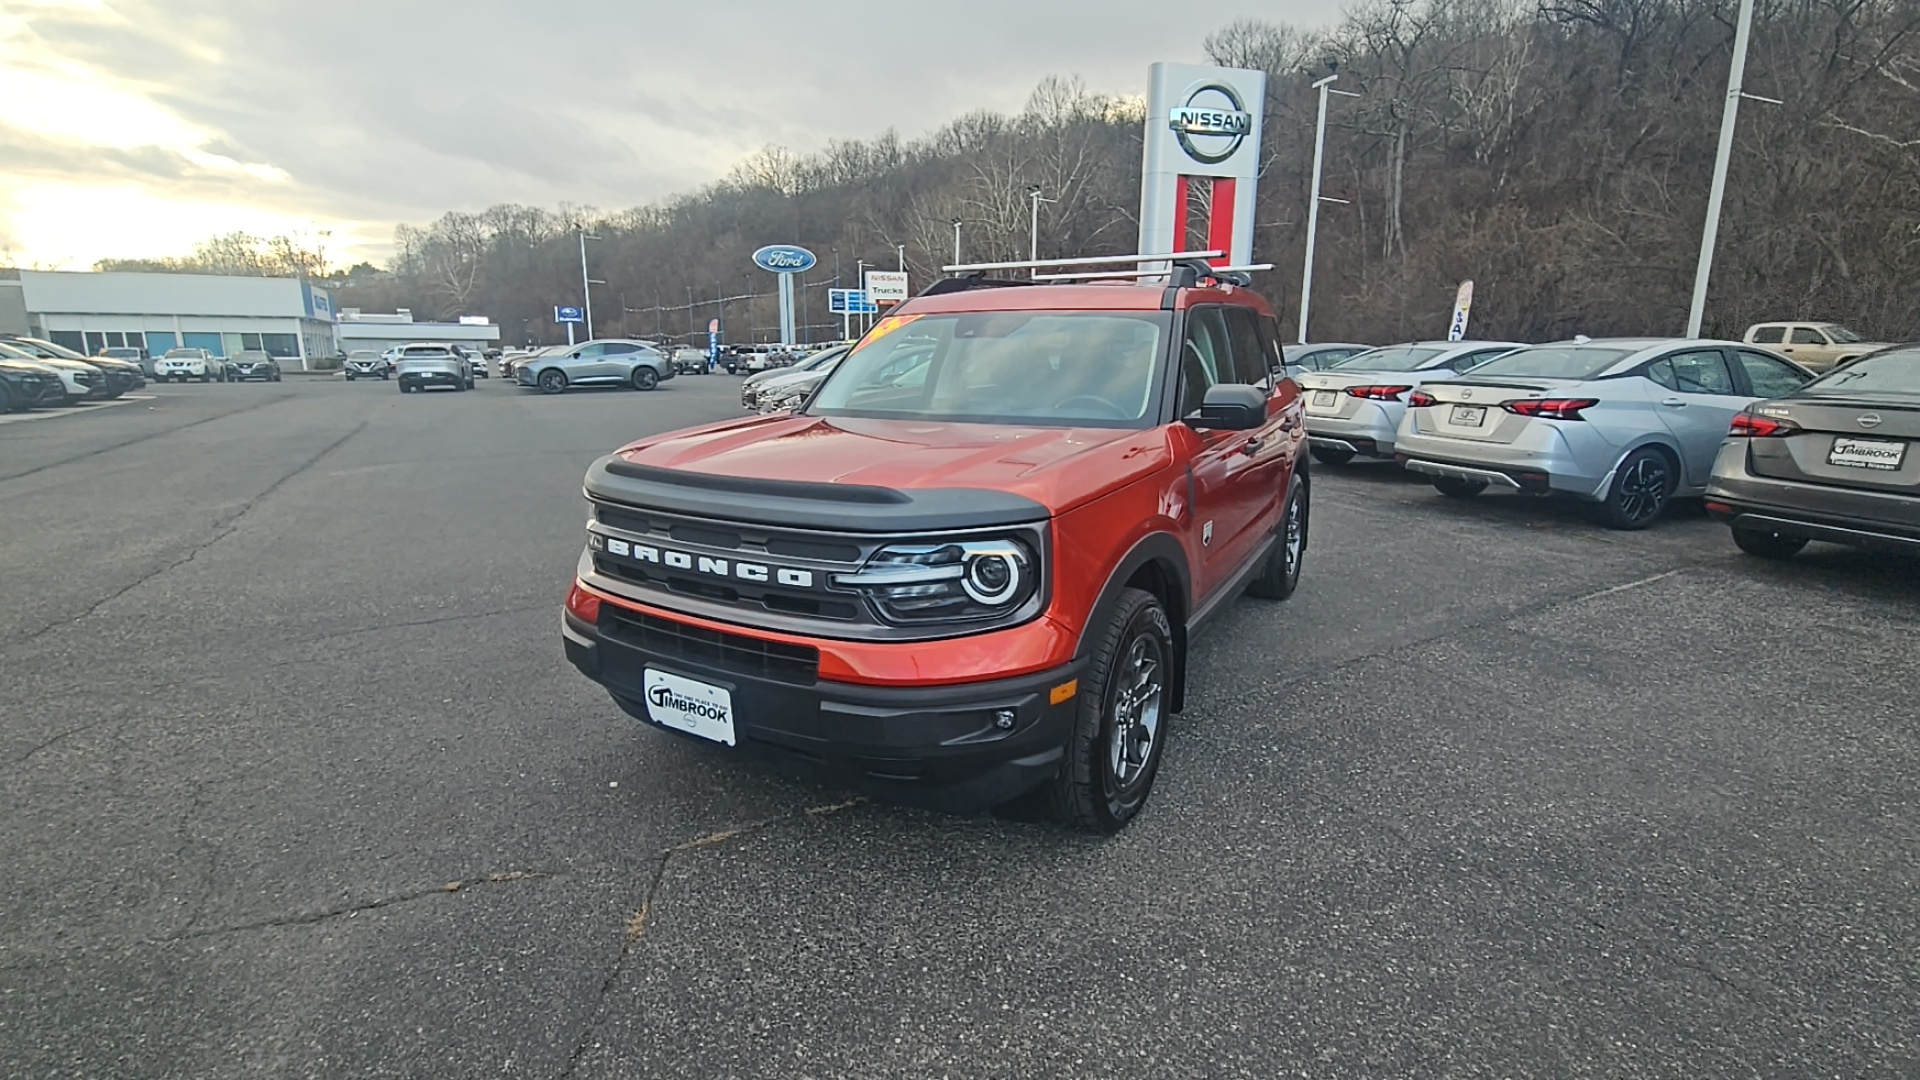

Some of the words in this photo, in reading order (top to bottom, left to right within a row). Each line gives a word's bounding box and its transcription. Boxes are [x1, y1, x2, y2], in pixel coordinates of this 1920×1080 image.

[1180, 112, 1246, 129] NISSAN
[767, 251, 802, 267] Ford
[1833, 444, 1900, 459] TIMBROOK
[607, 538, 813, 587] BRONCO
[648, 684, 727, 724] TIMBROOK
[695, 698, 710, 707] PLACE
